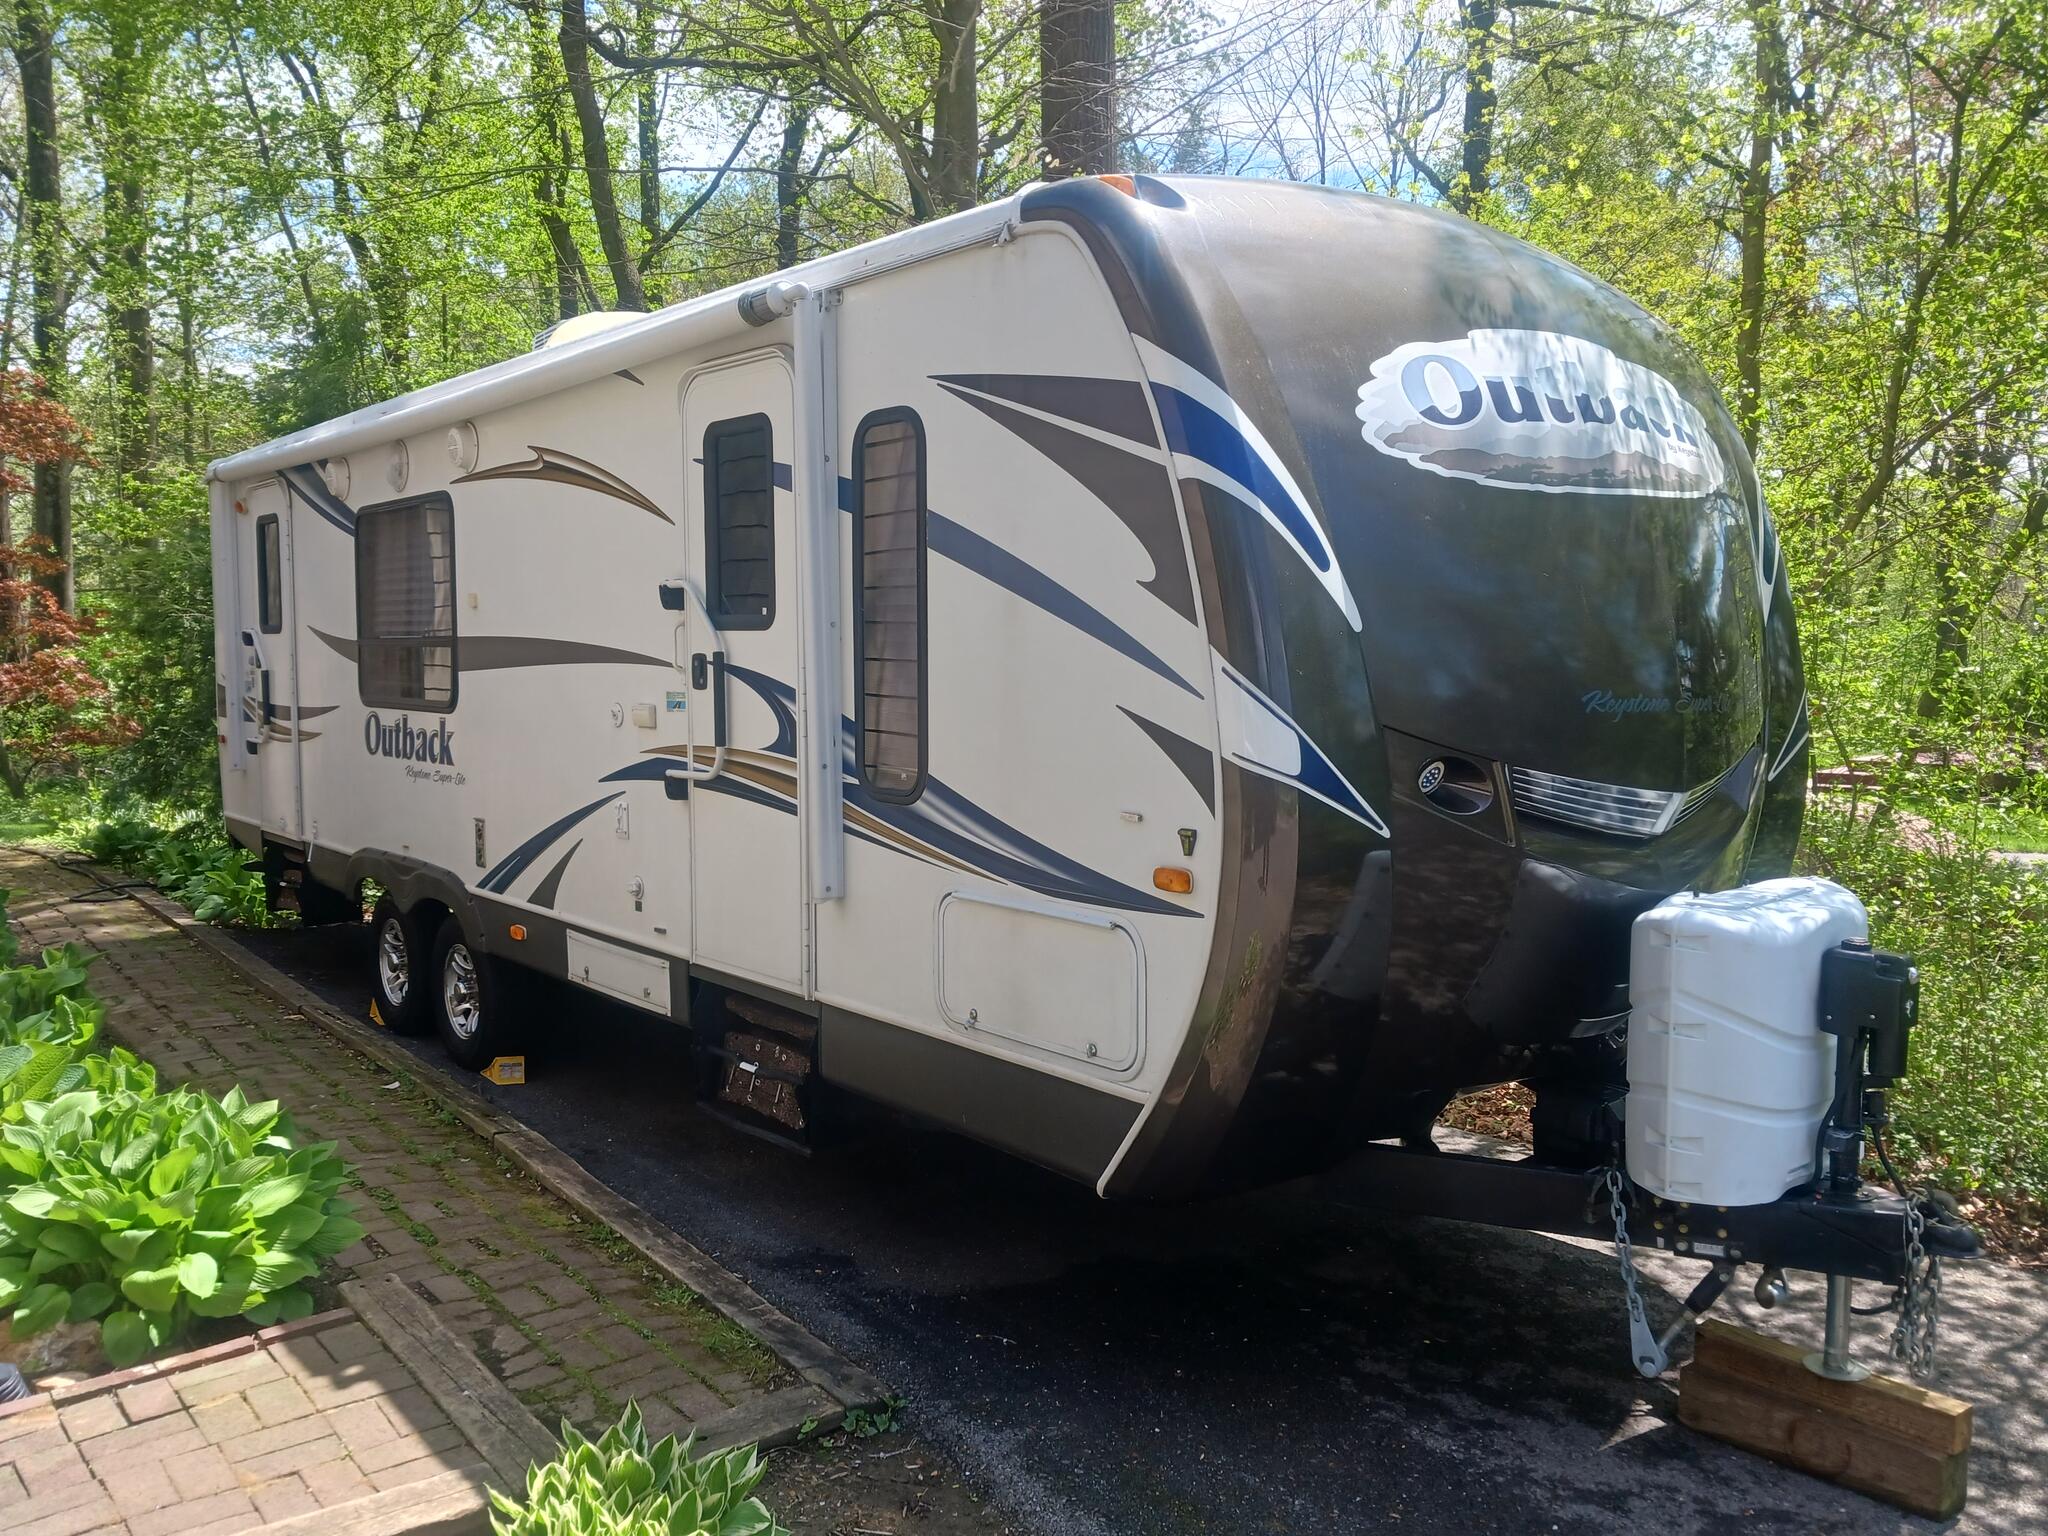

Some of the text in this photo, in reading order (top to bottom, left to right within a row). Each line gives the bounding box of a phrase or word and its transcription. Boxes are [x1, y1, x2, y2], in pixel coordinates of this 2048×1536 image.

[1400, 354, 1700, 449] Outback
[1581, 689, 1670, 723] Keystone
[364, 710, 456, 767] Outback
